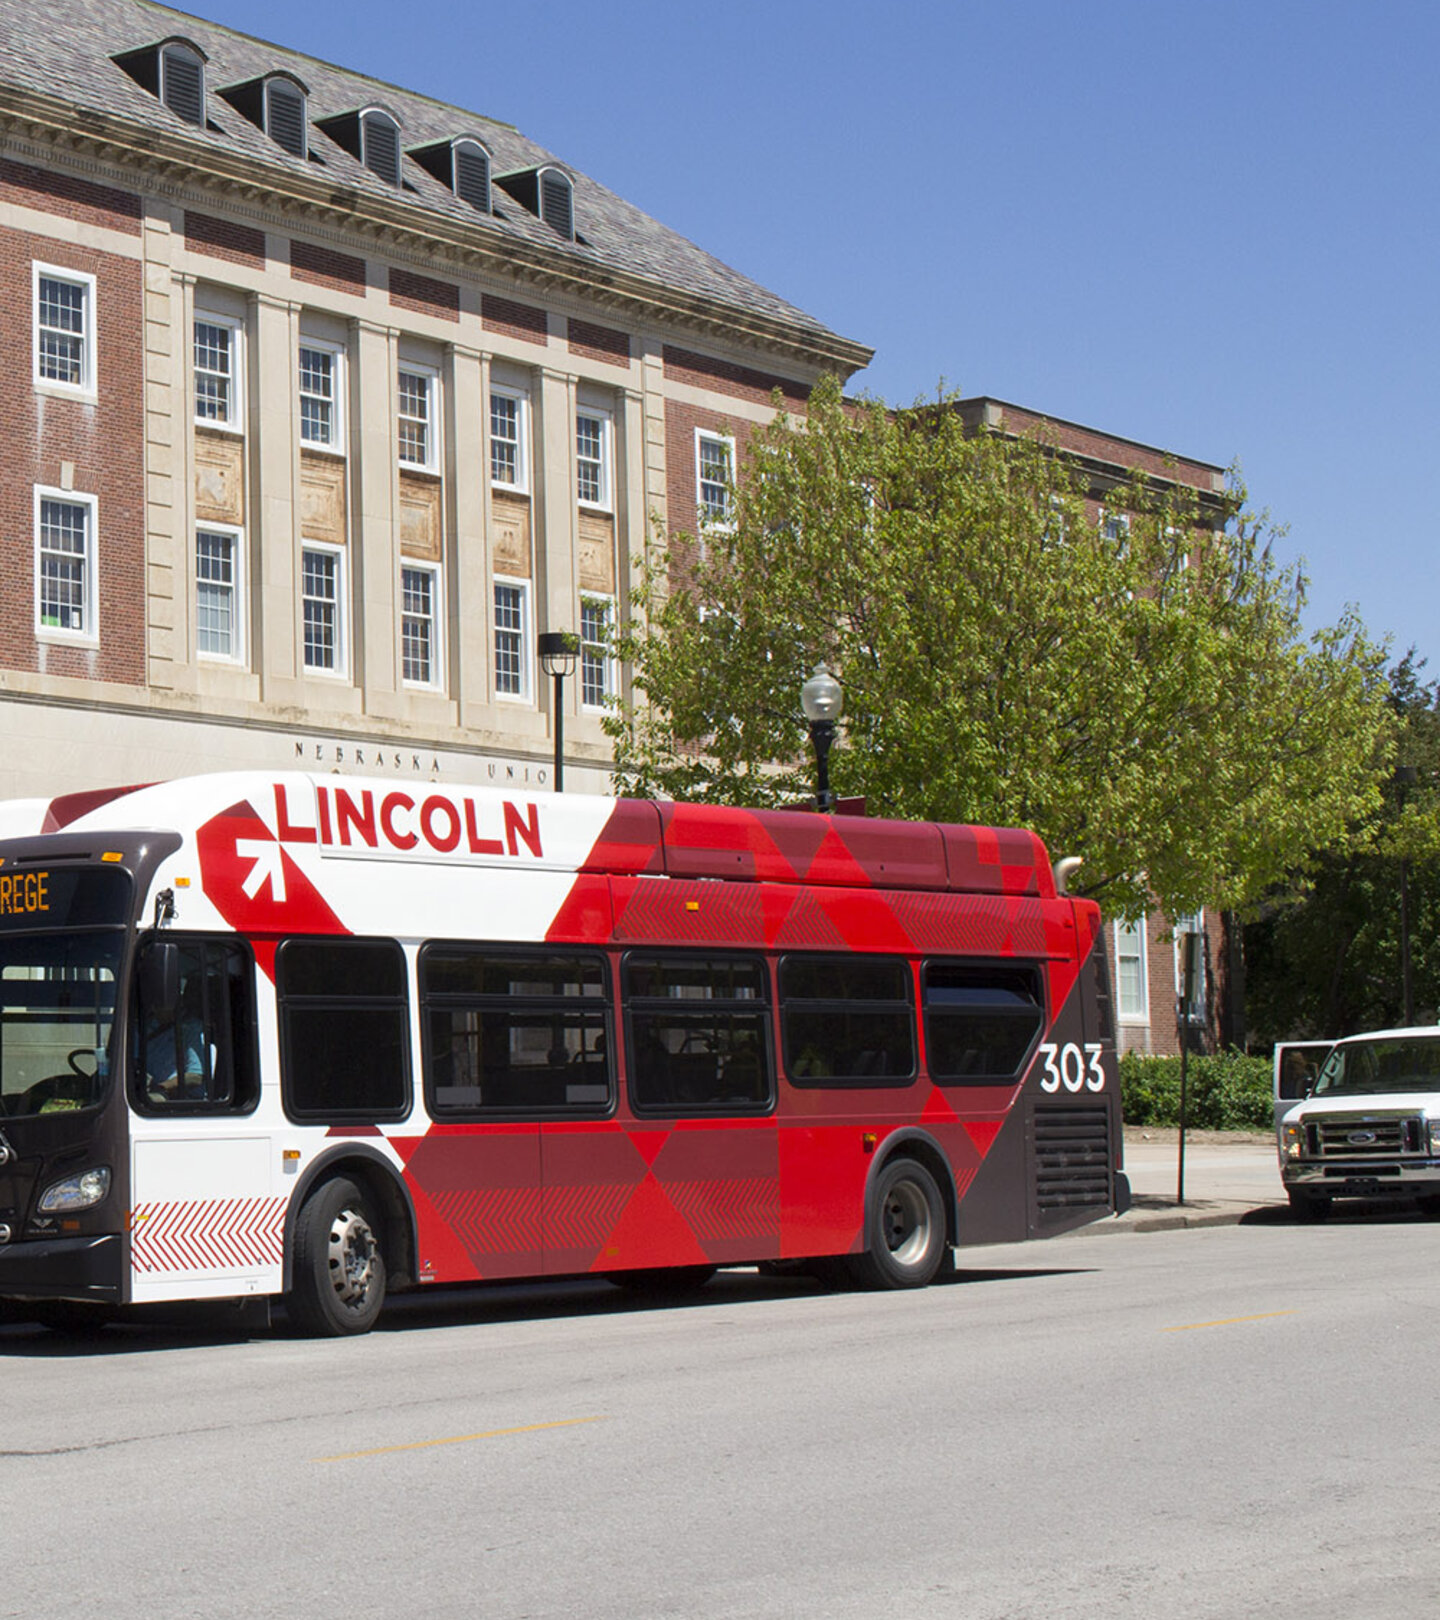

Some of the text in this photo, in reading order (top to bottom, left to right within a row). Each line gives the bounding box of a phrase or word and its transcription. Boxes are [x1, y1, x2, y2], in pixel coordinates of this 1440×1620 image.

[295, 742, 548, 785] NEBRASKA UNIO
[273, 784, 544, 858] LINCOLN
[1038, 1042, 1106, 1093] 303
